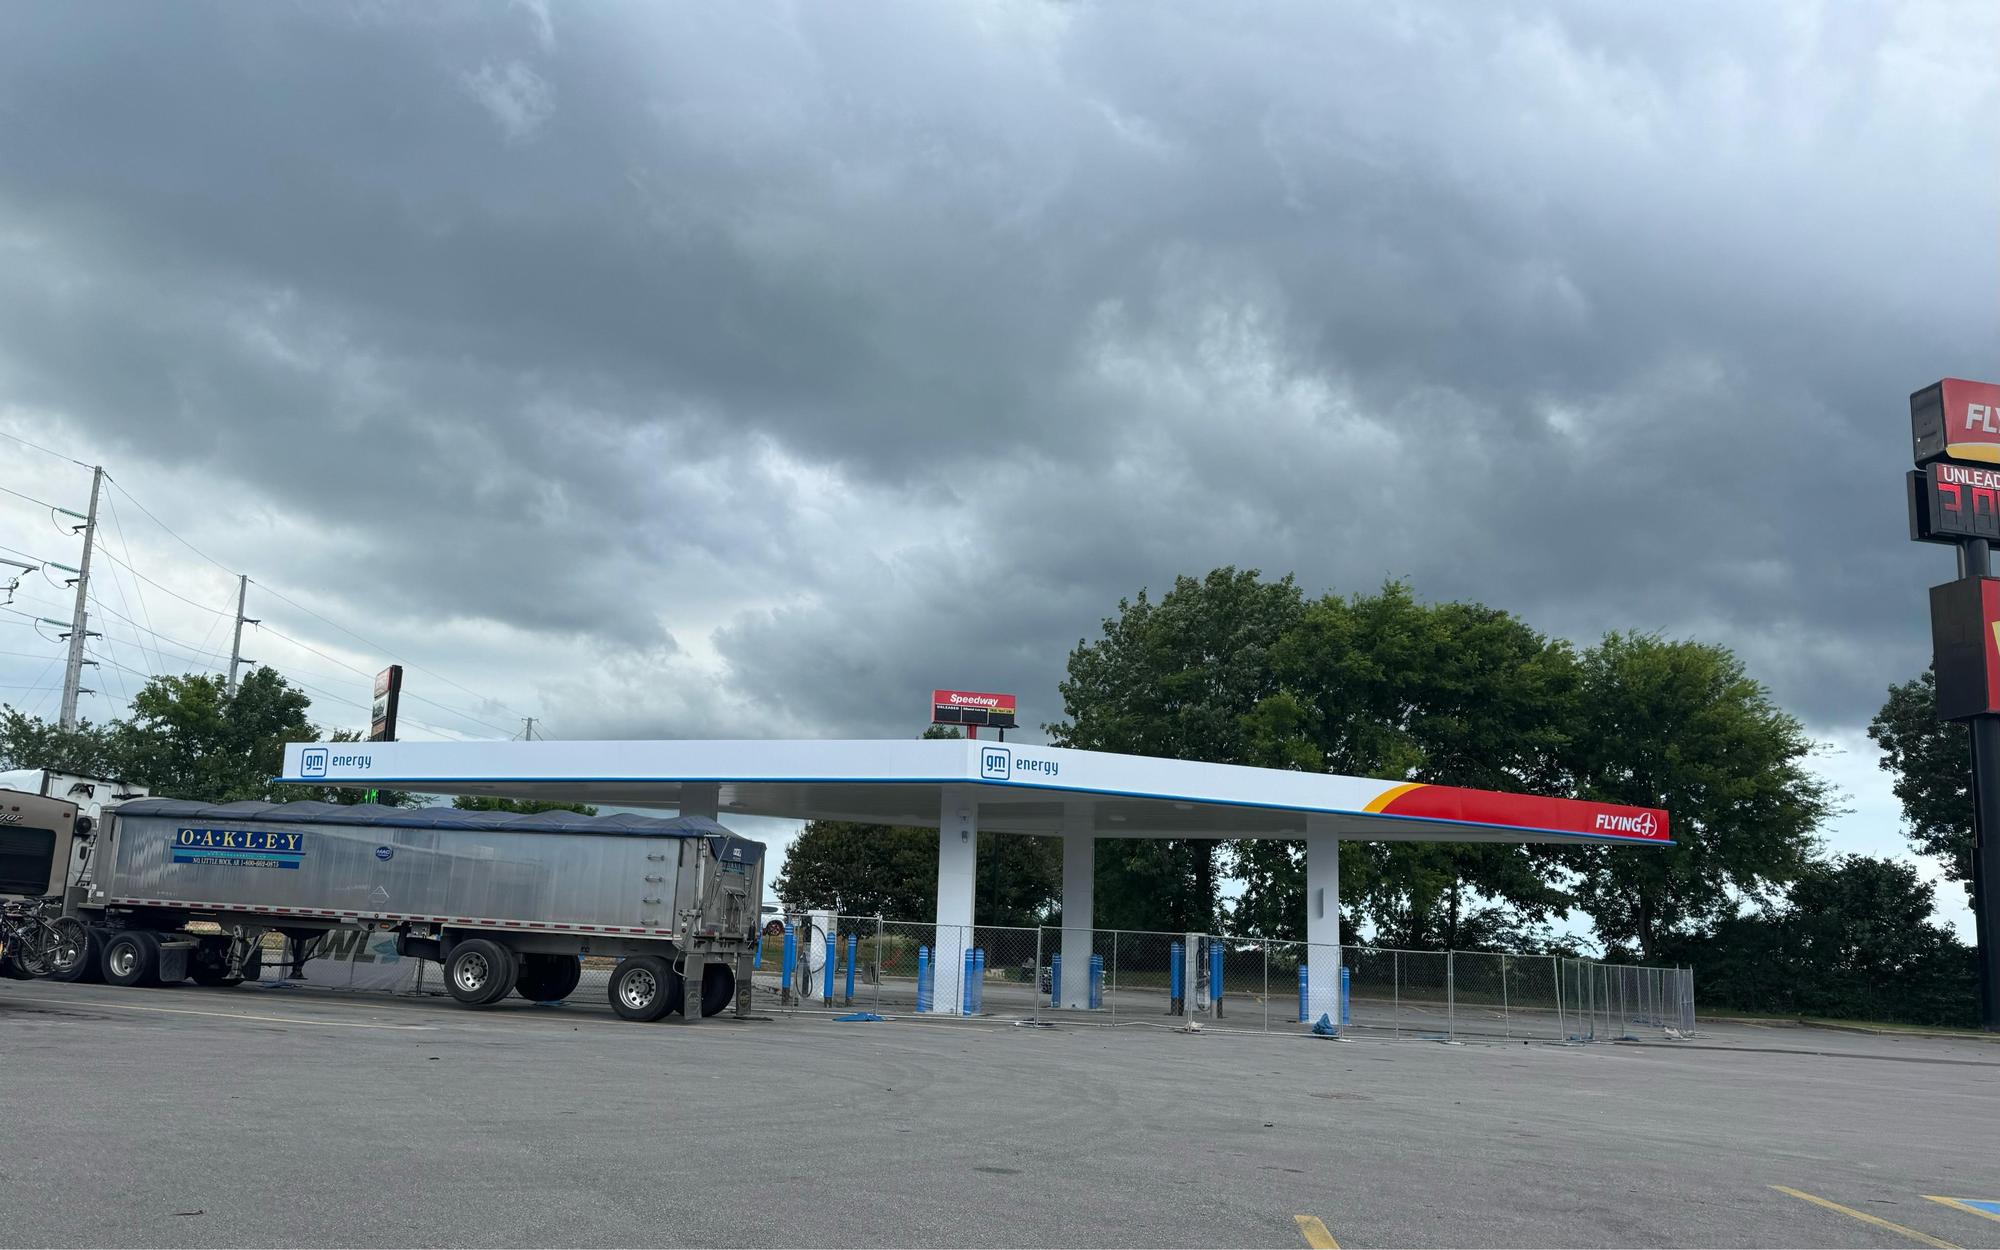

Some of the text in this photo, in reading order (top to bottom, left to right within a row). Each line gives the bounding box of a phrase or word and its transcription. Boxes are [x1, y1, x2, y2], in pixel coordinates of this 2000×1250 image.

[1965, 403, 2000, 434] FL
[950, 693, 998, 706] Speedway
[306, 755, 372, 770] gm energy
[986, 755, 1059, 776] gm energy
